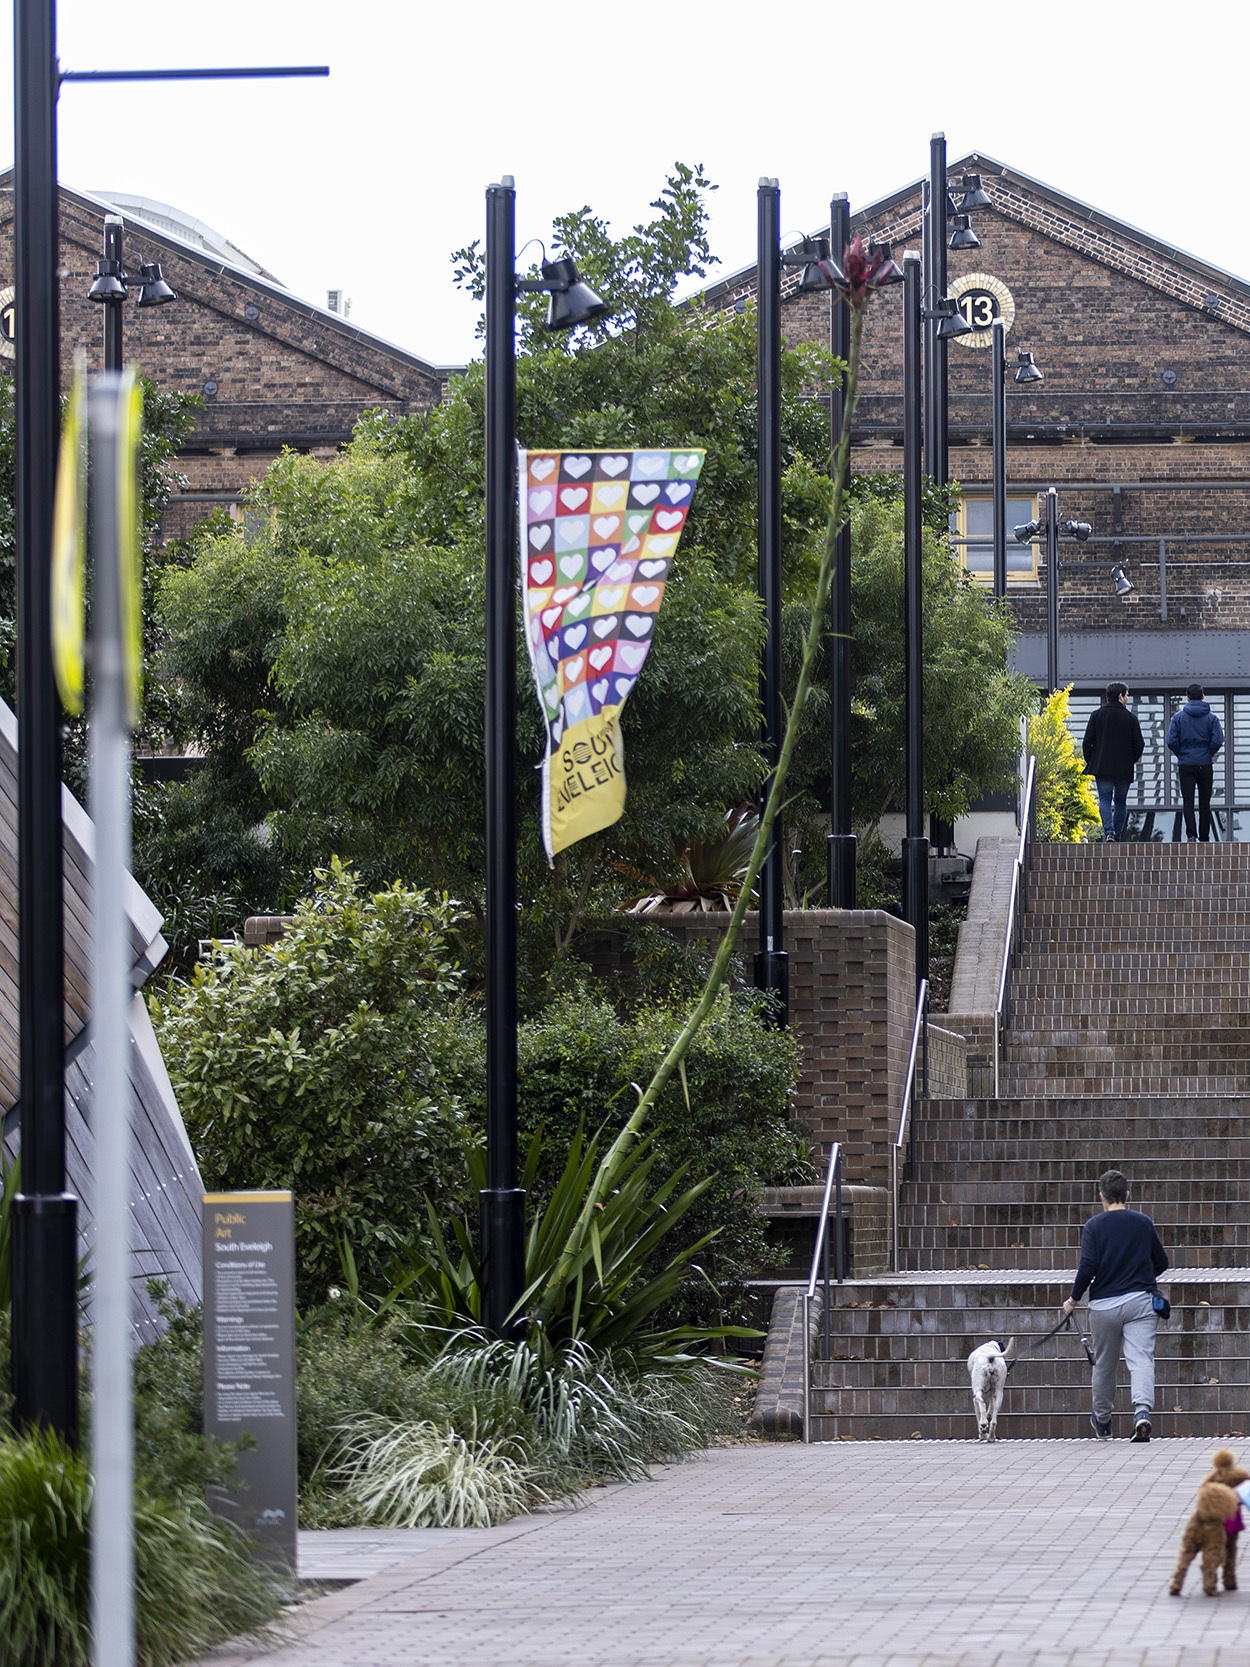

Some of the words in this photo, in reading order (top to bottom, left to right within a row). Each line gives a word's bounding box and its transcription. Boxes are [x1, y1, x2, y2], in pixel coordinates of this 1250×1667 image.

[961, 296, 993, 326] 13
[3, 308, 15, 339] 1
[215, 1213, 246, 1224] Public
[215, 1228, 232, 1239] Art
[215, 1242, 239, 1251] South
[240, 1241, 273, 1253] Eveleigh
